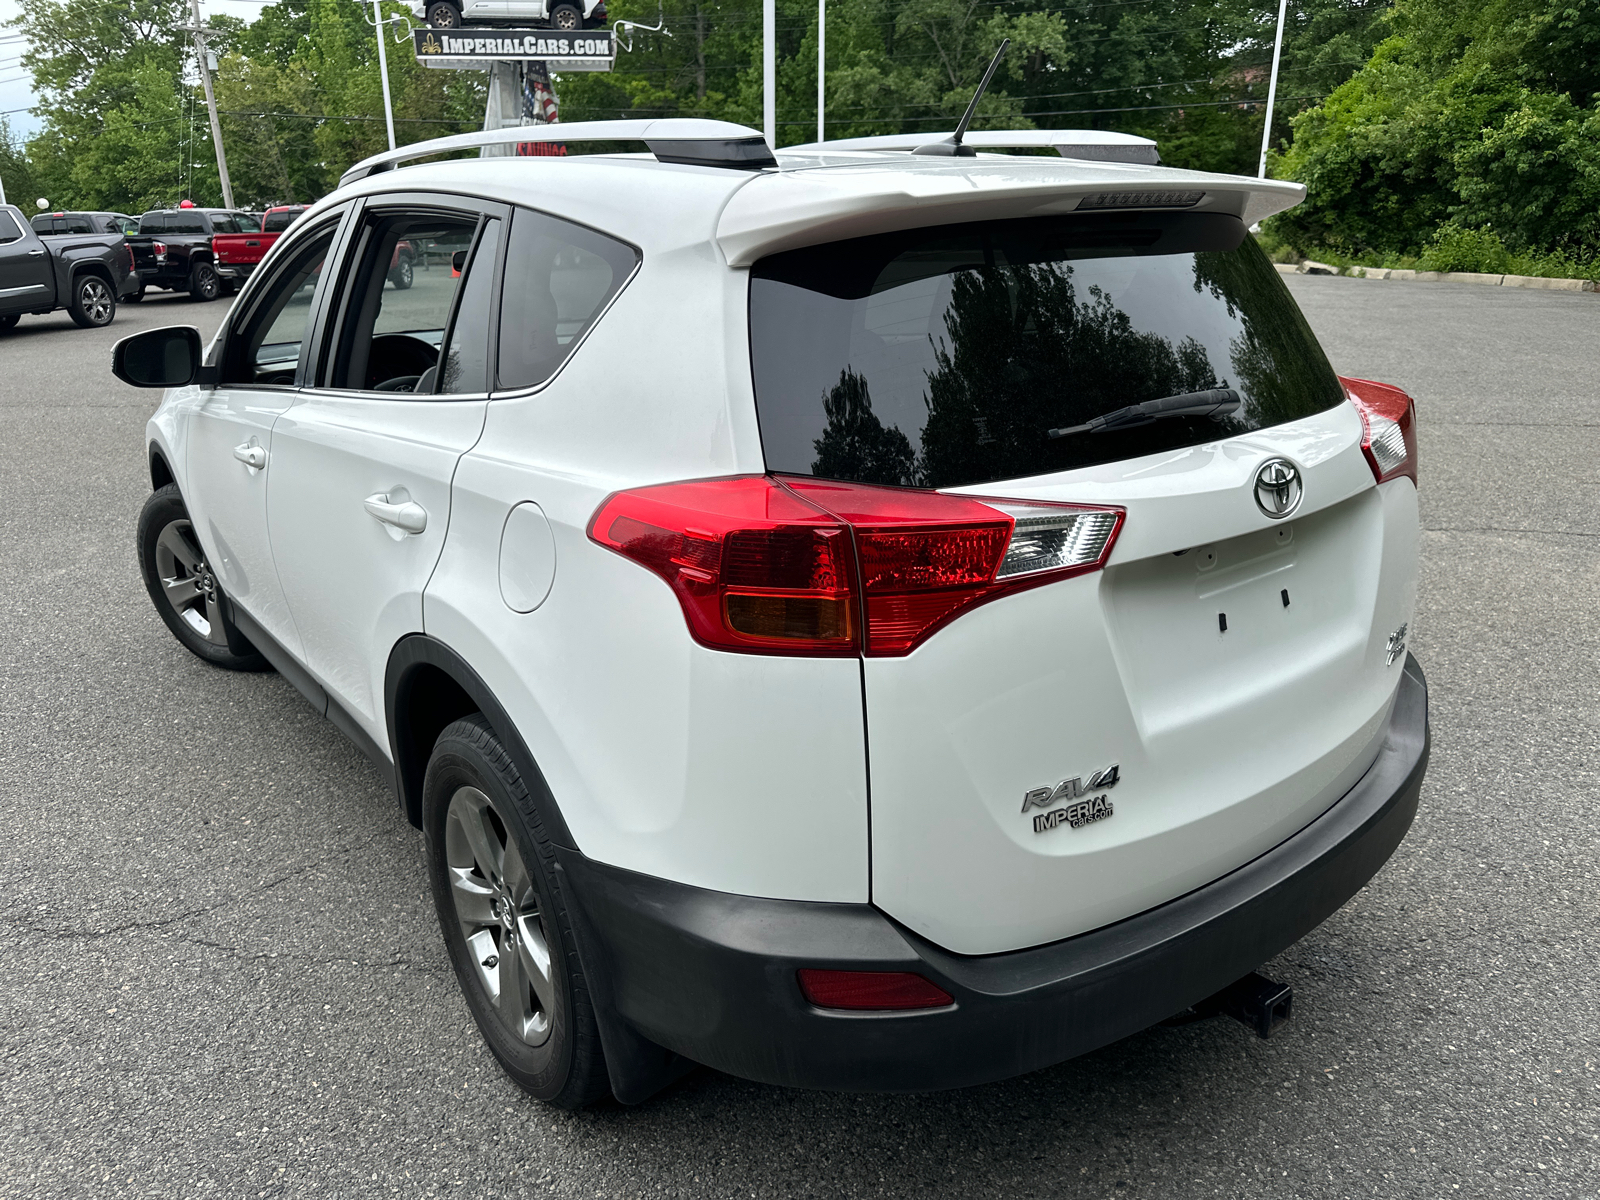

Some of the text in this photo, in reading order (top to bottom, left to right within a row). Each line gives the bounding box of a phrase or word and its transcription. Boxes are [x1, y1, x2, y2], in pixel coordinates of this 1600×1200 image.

[441, 35, 609, 54] IMPERIALCARS.COM
[1021, 763, 1120, 813] RAV4
[1033, 794, 1113, 832] IMPERIAL
[1071, 807, 1113, 828] cars.com
